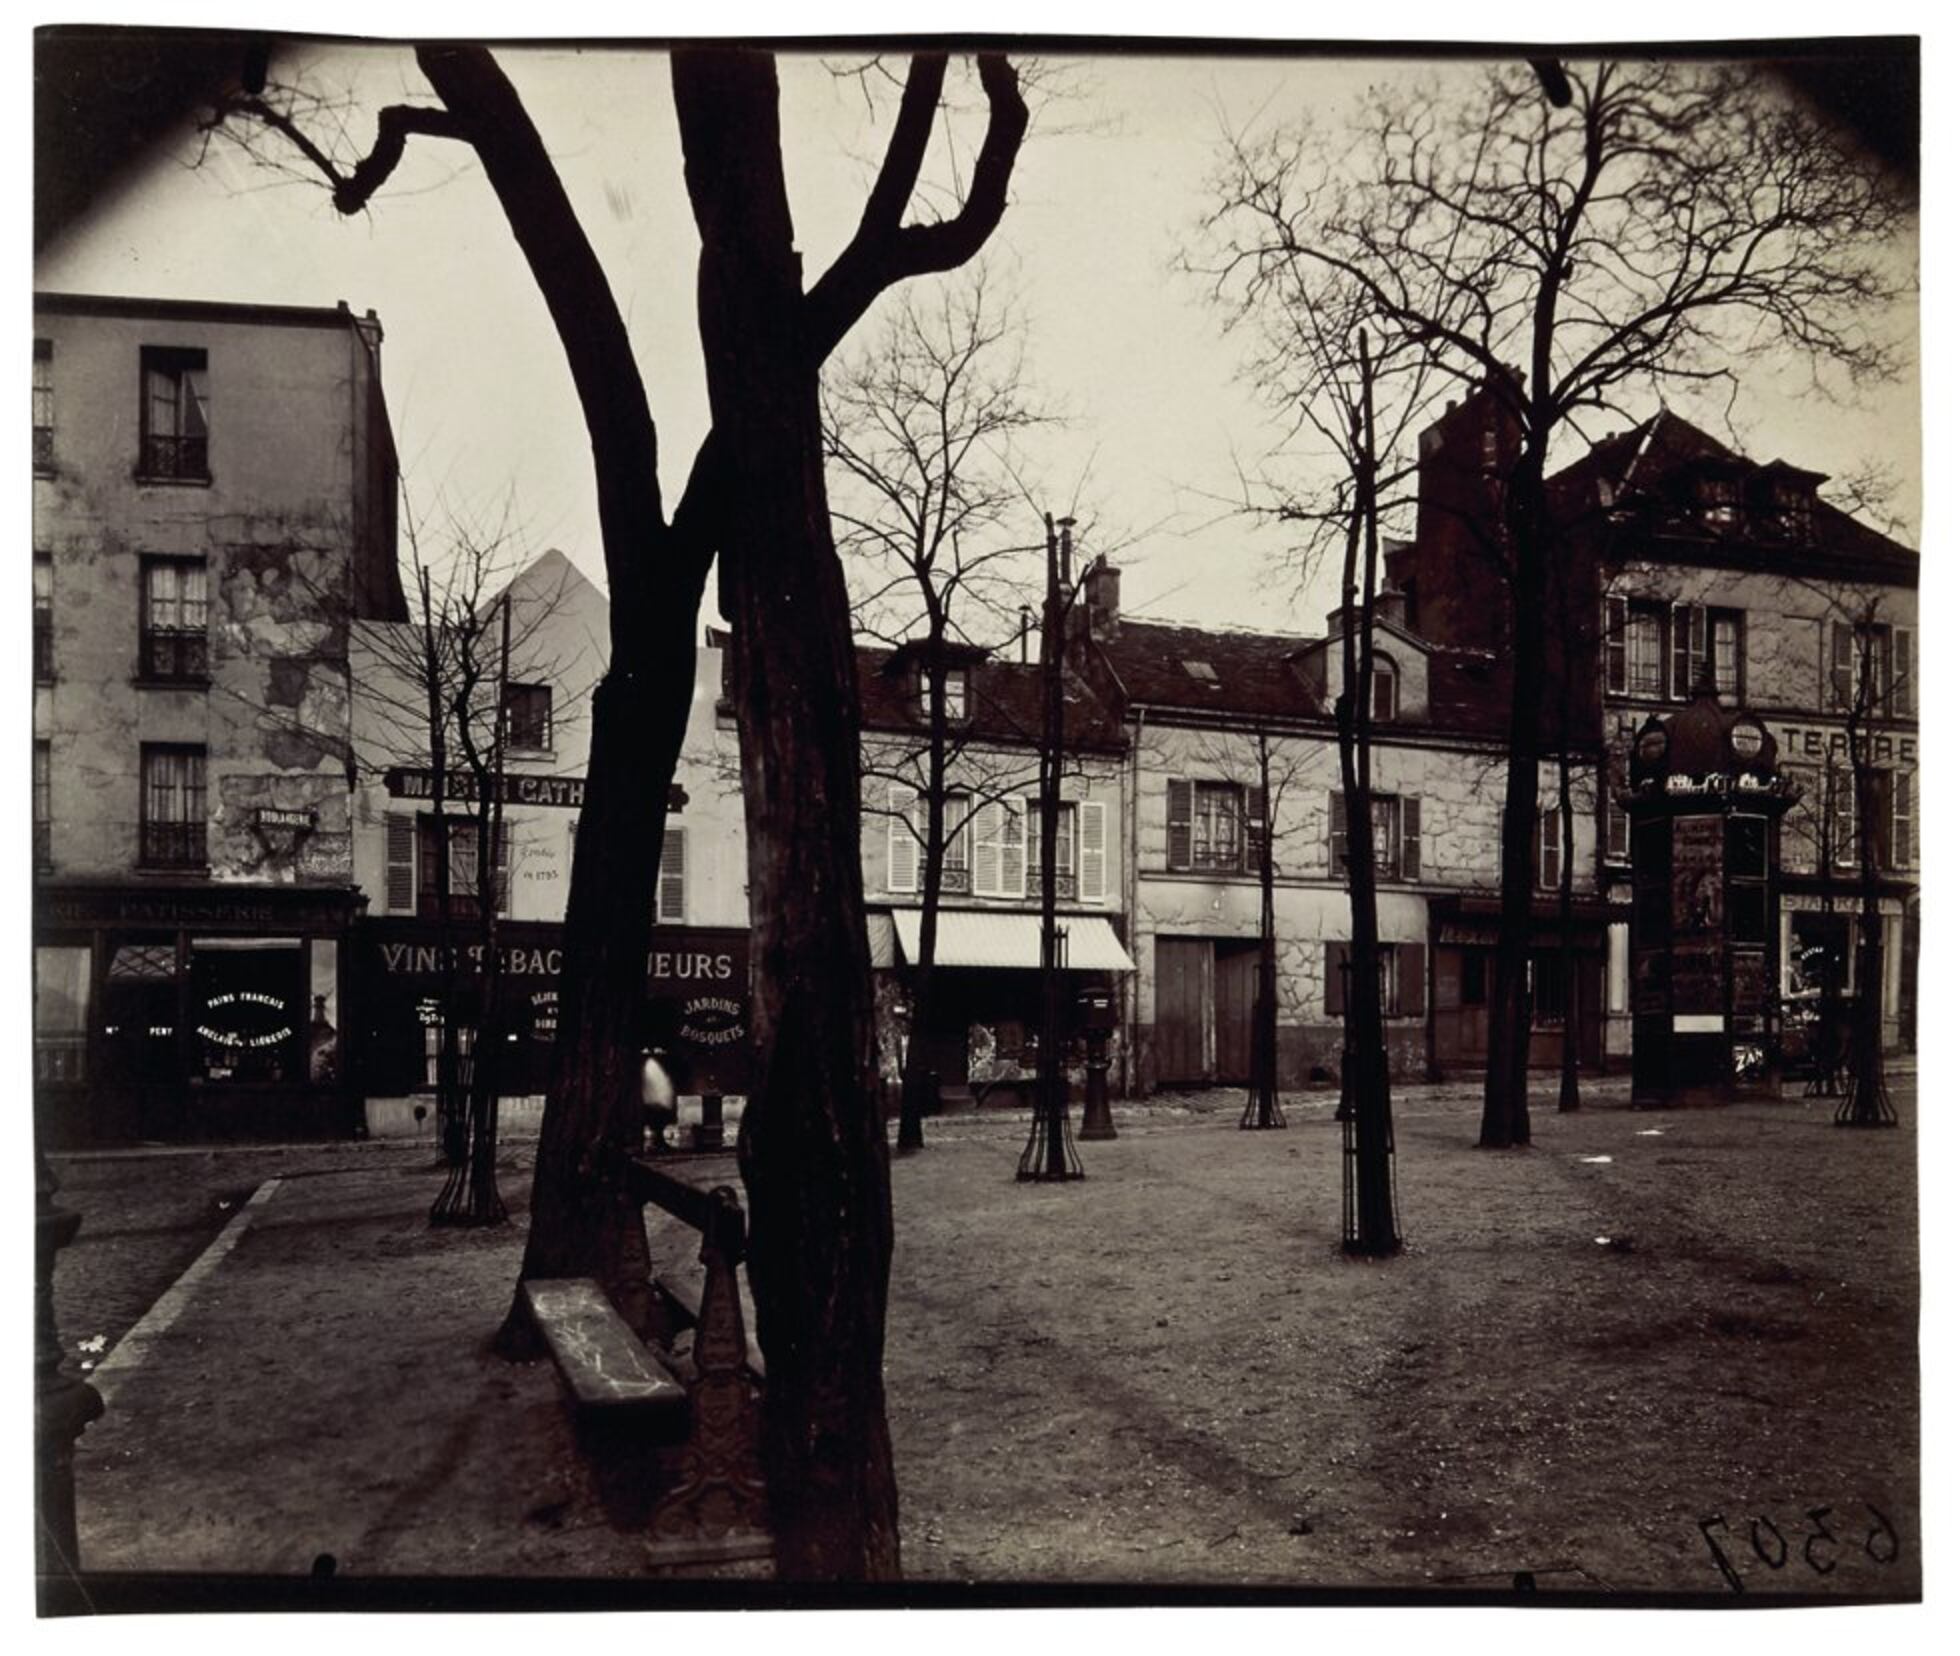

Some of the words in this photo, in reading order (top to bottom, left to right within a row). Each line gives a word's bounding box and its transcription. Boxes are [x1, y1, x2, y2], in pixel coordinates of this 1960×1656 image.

[468, 945, 564, 975] TBAC
[684, 996, 741, 1016] JARDINS
[680, 1023, 746, 1046] BOSQUETS
